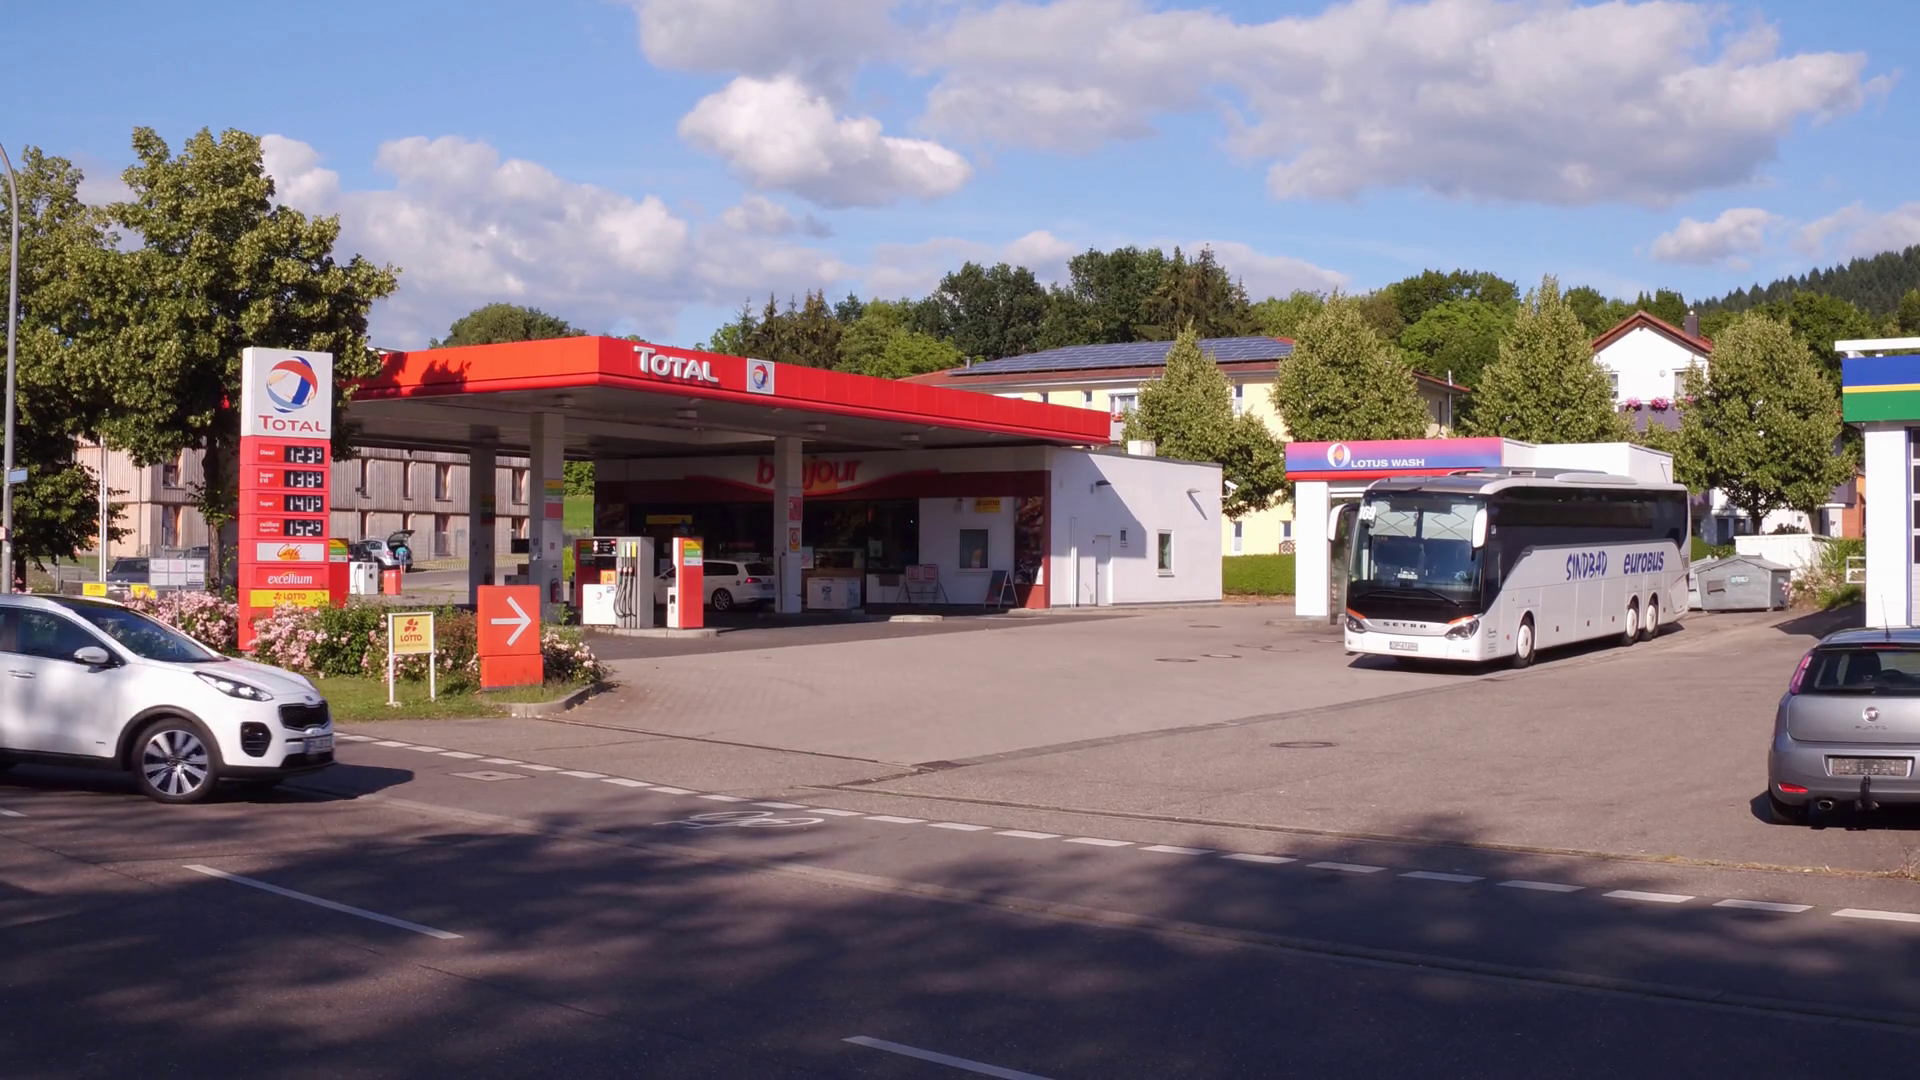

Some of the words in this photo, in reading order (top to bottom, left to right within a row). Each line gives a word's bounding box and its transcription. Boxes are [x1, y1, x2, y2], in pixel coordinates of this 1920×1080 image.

[634, 345, 719, 383] TOTAL
[258, 415, 326, 433] TOTAL
[1351, 459, 1388, 468] LOTUS
[1391, 458, 1425, 467] WASH
[757, 456, 863, 490] bjour
[1359, 505, 1377, 520] 169
[1566, 550, 1608, 581] SINDBAD
[268, 573, 313, 585] excellium
[1383, 621, 1427, 629] SETRA
[400, 634, 423, 642] LOTTO
